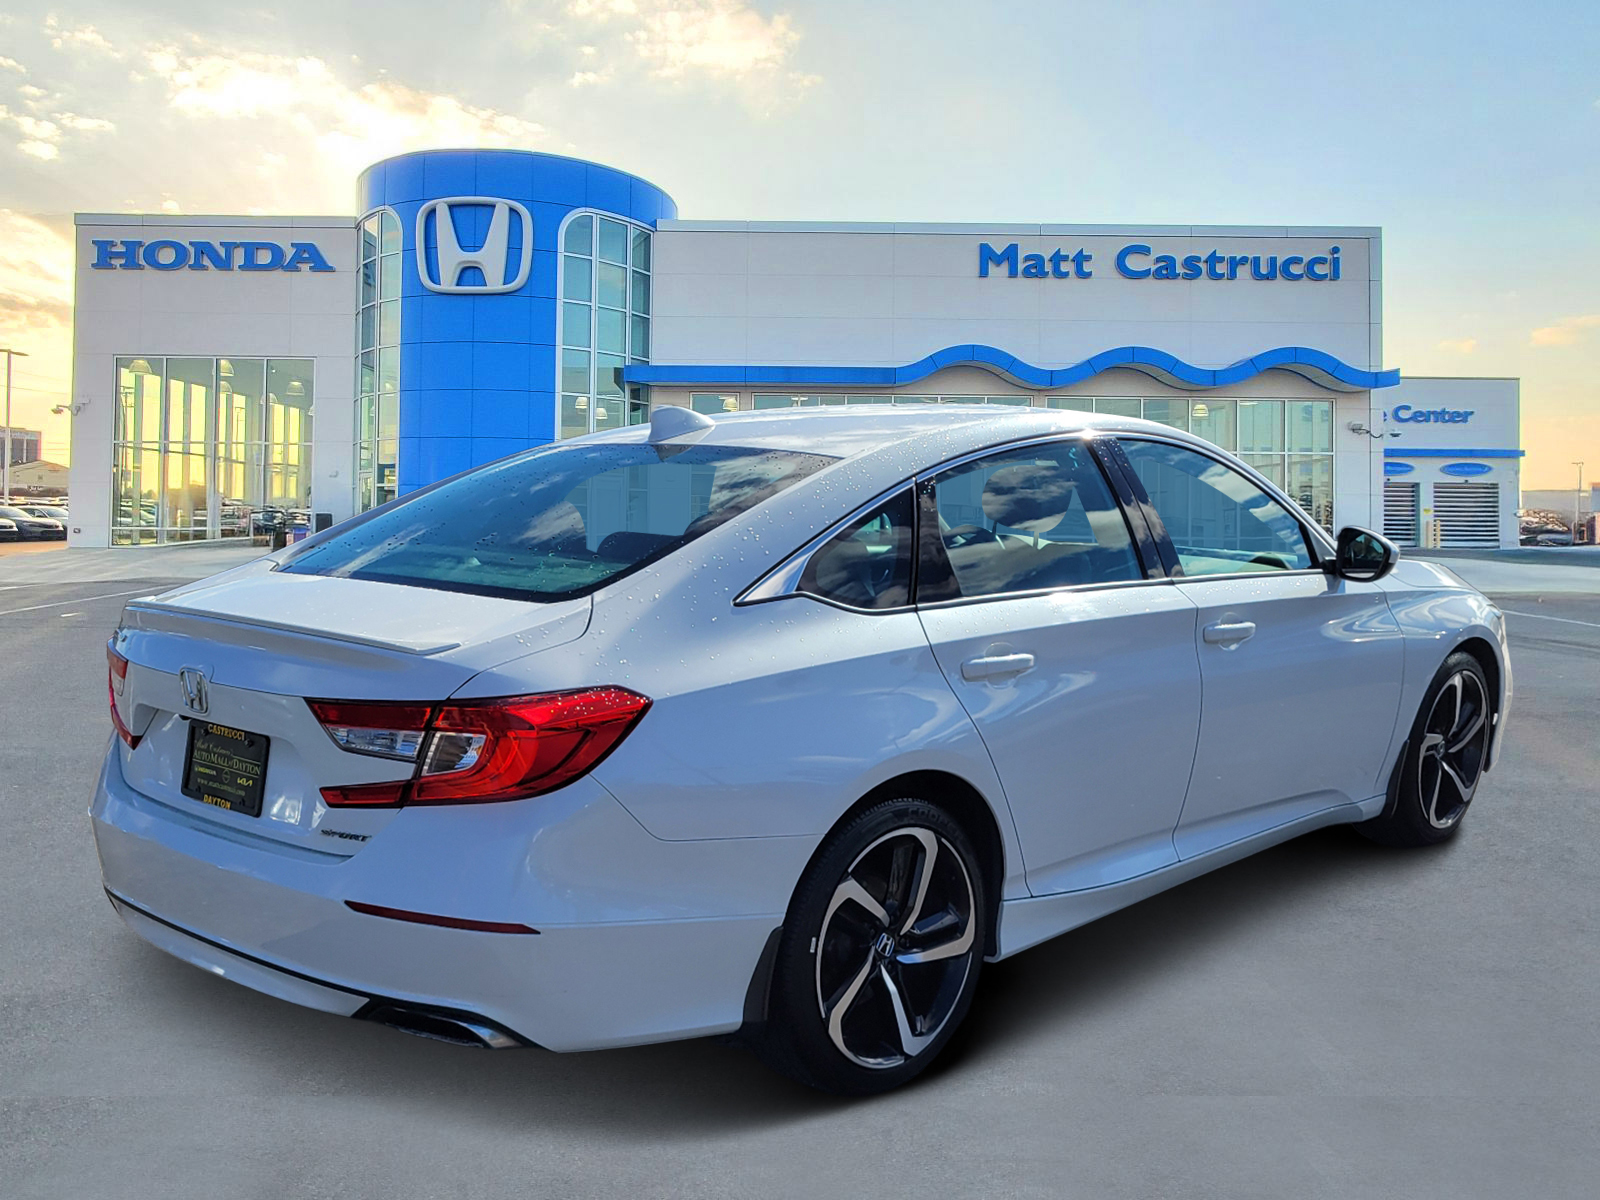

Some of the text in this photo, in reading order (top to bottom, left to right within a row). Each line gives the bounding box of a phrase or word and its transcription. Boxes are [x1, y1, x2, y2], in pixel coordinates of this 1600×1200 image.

[91, 239, 336, 272] HONDA
[979, 242, 1342, 281] Matt Castrucci
[1392, 404, 1475, 424] Center
[207, 723, 246, 741] CASTRUCCI
[203, 793, 231, 810] DAYTON
[321, 829, 372, 842] SPORT
